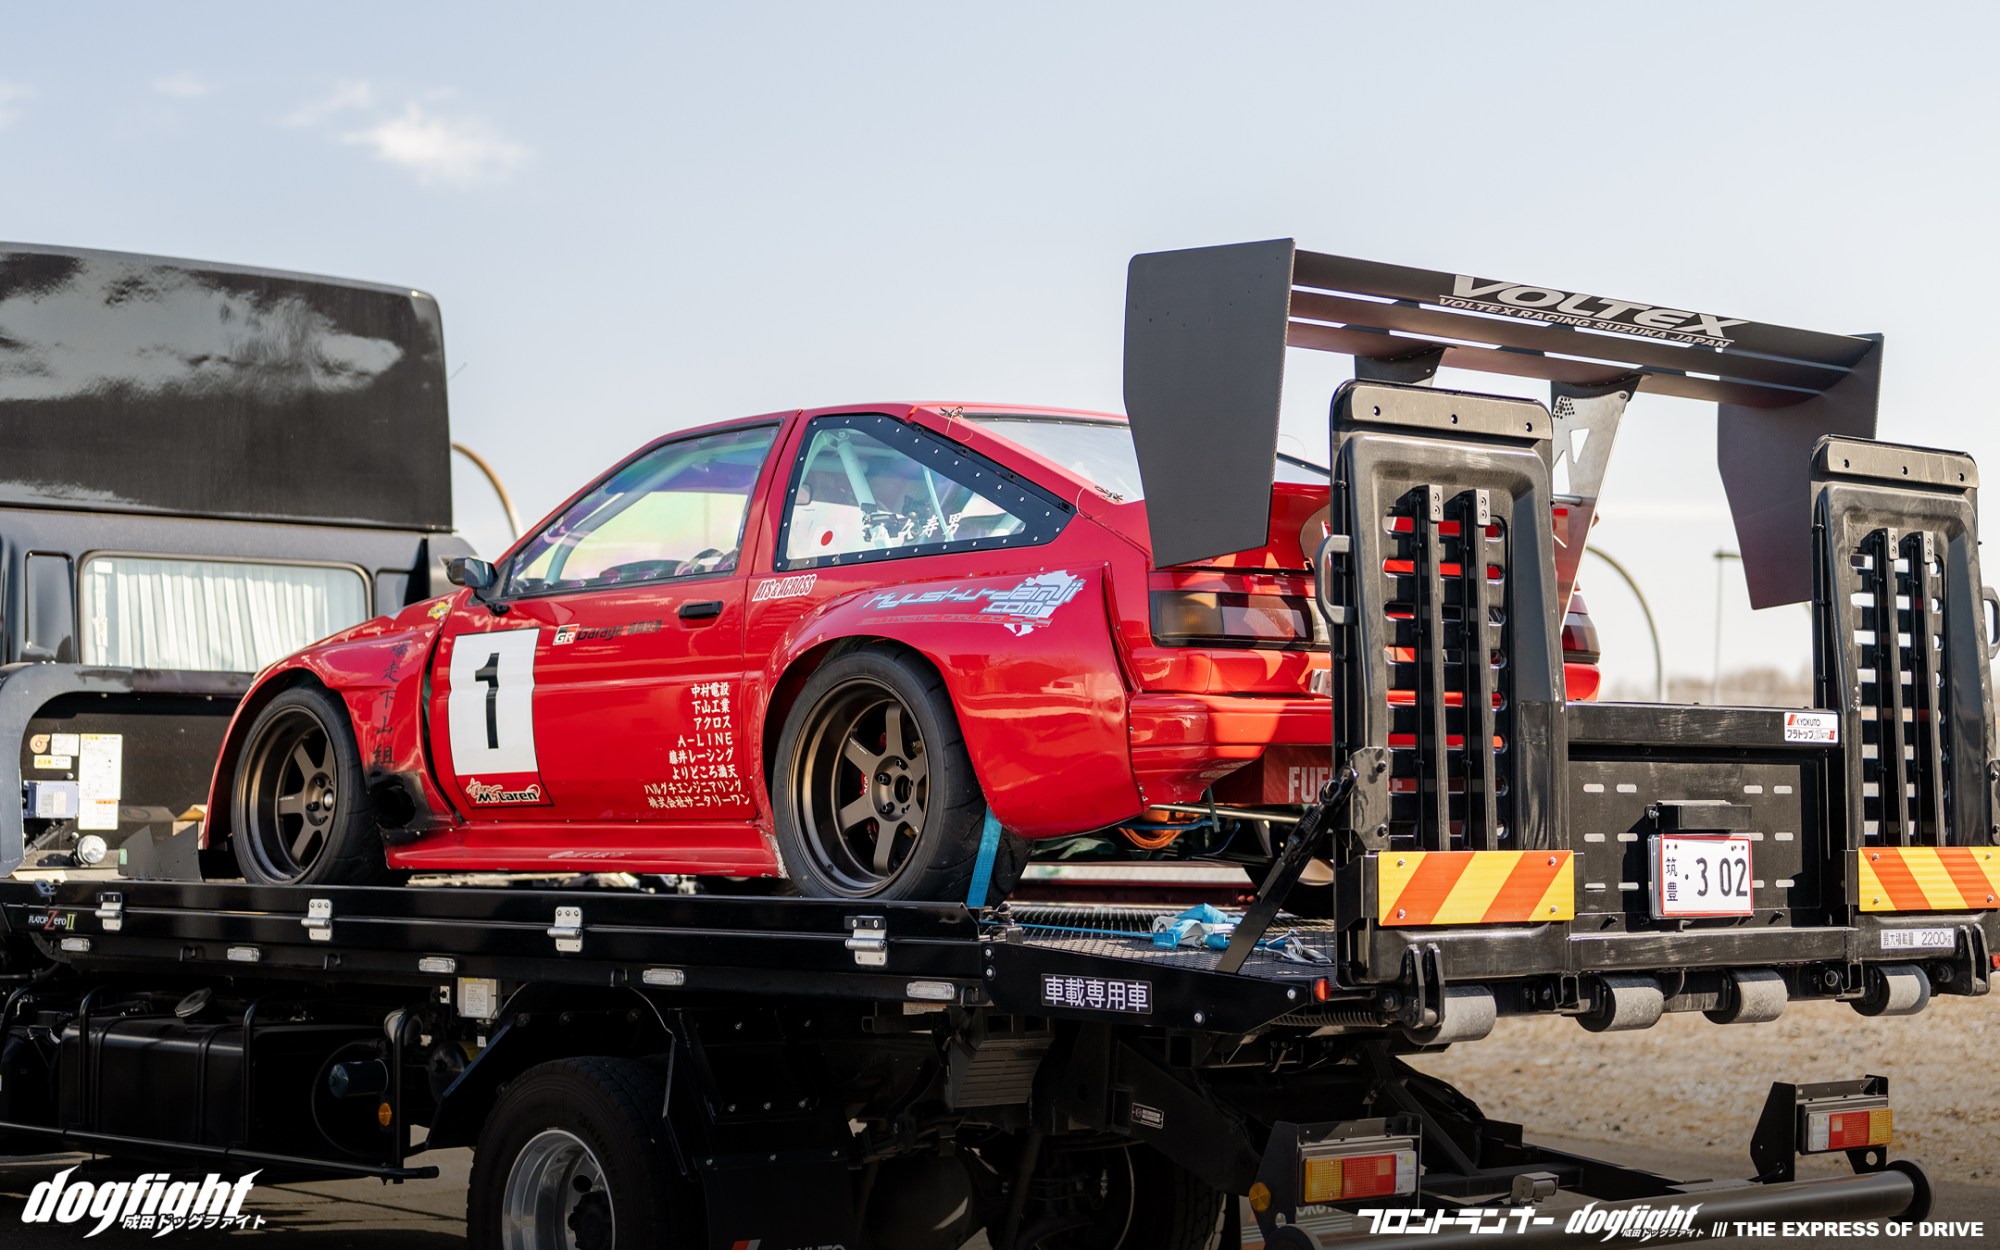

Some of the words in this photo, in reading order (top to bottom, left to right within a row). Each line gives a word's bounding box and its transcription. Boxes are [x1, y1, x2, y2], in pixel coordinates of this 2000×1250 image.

[1439, 298, 1515, 316] VOLTEX
[1518, 310, 1590, 327] RACING
[1592, 321, 1668, 340] SUZUKA
[1669, 333, 1730, 348] JAPAN
[1453, 275, 1750, 337] VOLTEX
[577, 626, 621, 641] Garage
[475, 653, 499, 749] 1
[691, 682, 729, 698] 中村電設
[692, 698, 730, 714] 下山工業
[693, 715, 732, 730] アクロス
[1288, 766, 1333, 803] FUE
[1045, 976, 1148, 1012] 車載専用車
